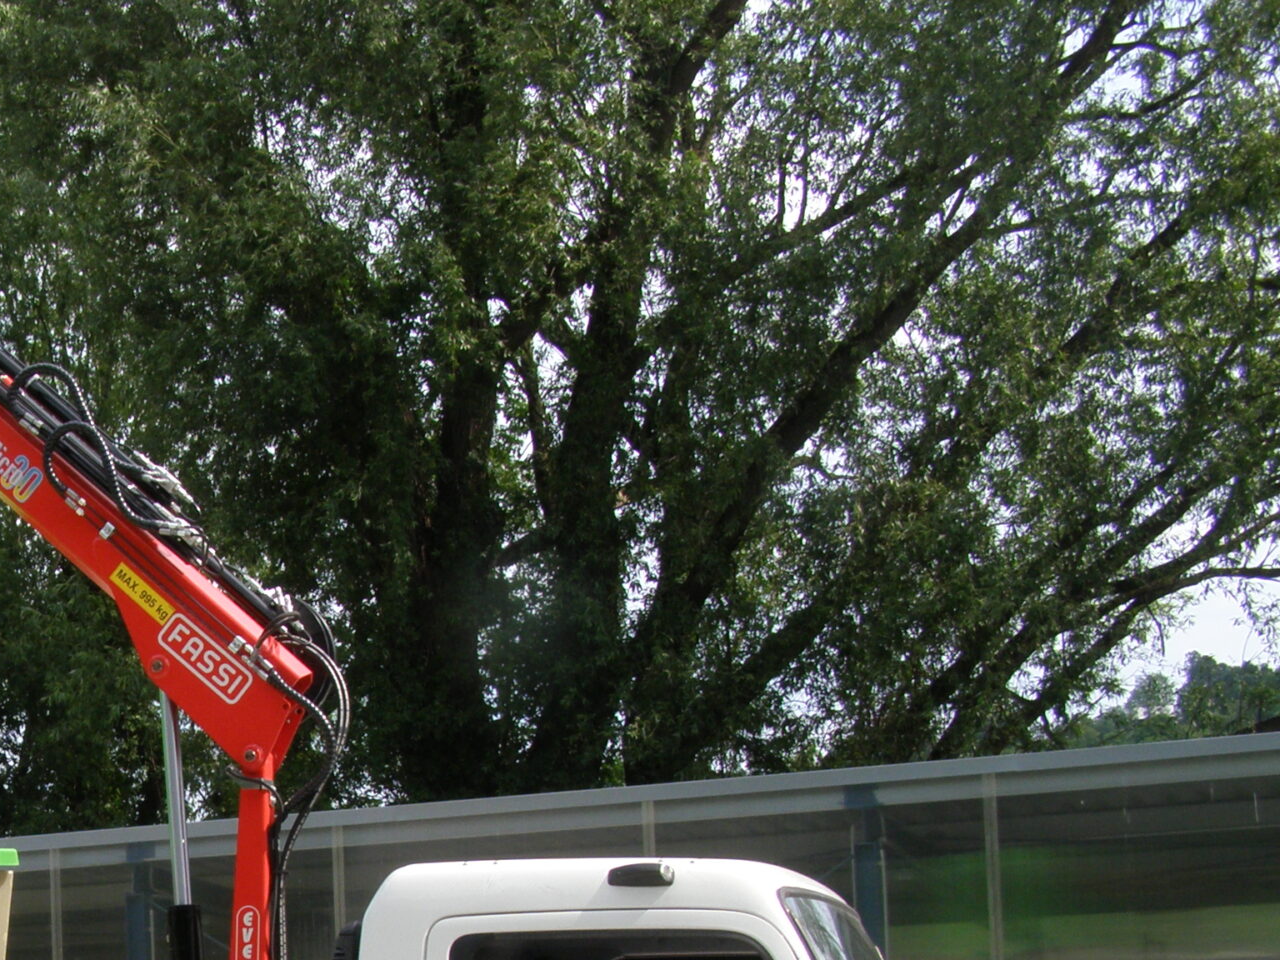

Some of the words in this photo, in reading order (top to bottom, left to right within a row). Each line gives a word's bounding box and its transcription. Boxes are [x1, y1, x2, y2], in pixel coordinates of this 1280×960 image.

[116, 569, 138, 594] MAX.
[139, 589, 158, 608] 995
[155, 604, 169, 621] kg
[167, 623, 243, 694] FASSI
